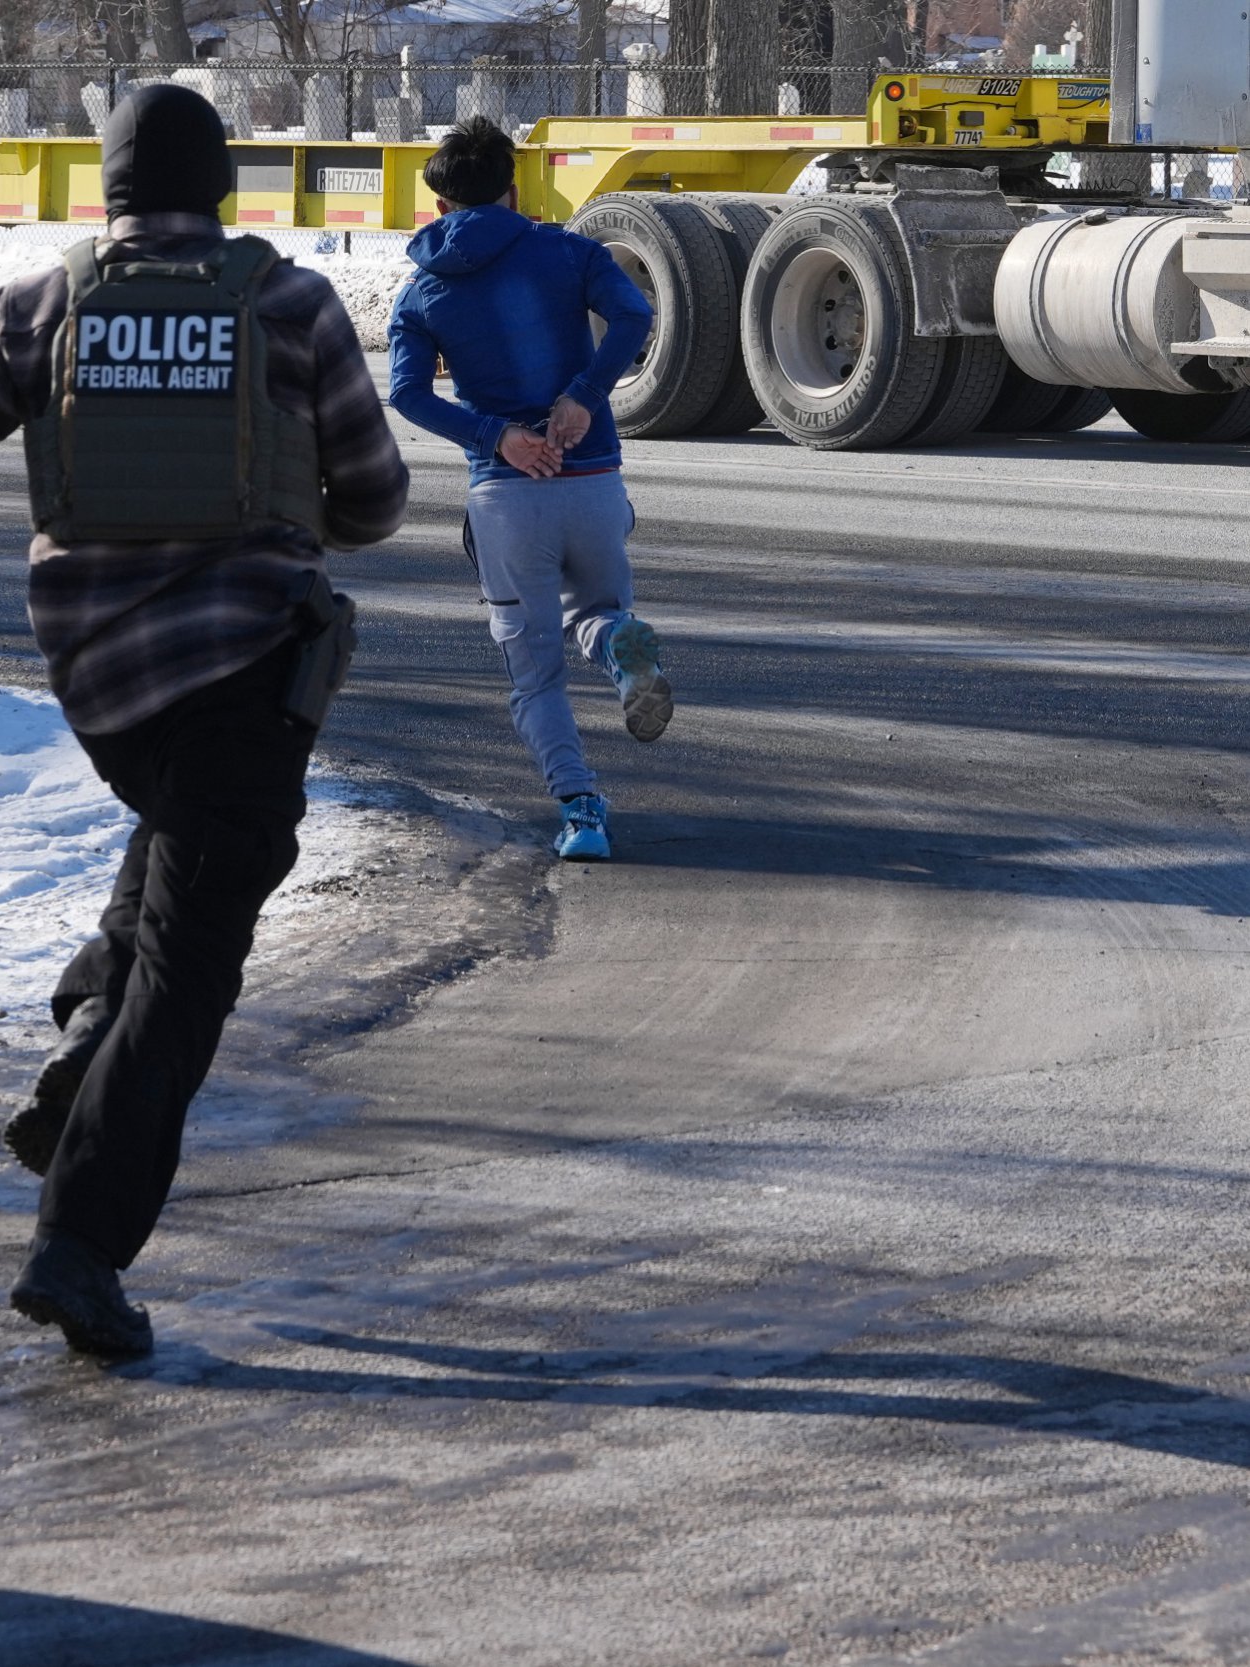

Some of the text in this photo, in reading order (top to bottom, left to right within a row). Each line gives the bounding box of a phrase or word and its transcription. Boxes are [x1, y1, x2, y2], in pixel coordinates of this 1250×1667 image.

[981, 80, 1021, 95] 91026
[955, 131, 982, 145] 77741
[319, 170, 381, 192] RHTE77741
[573, 212, 636, 238] INENTAL
[78, 315, 235, 361] POLICE
[76, 366, 233, 389] FEDERAL AGENT
[793, 355, 877, 428] CONTINENTAL
